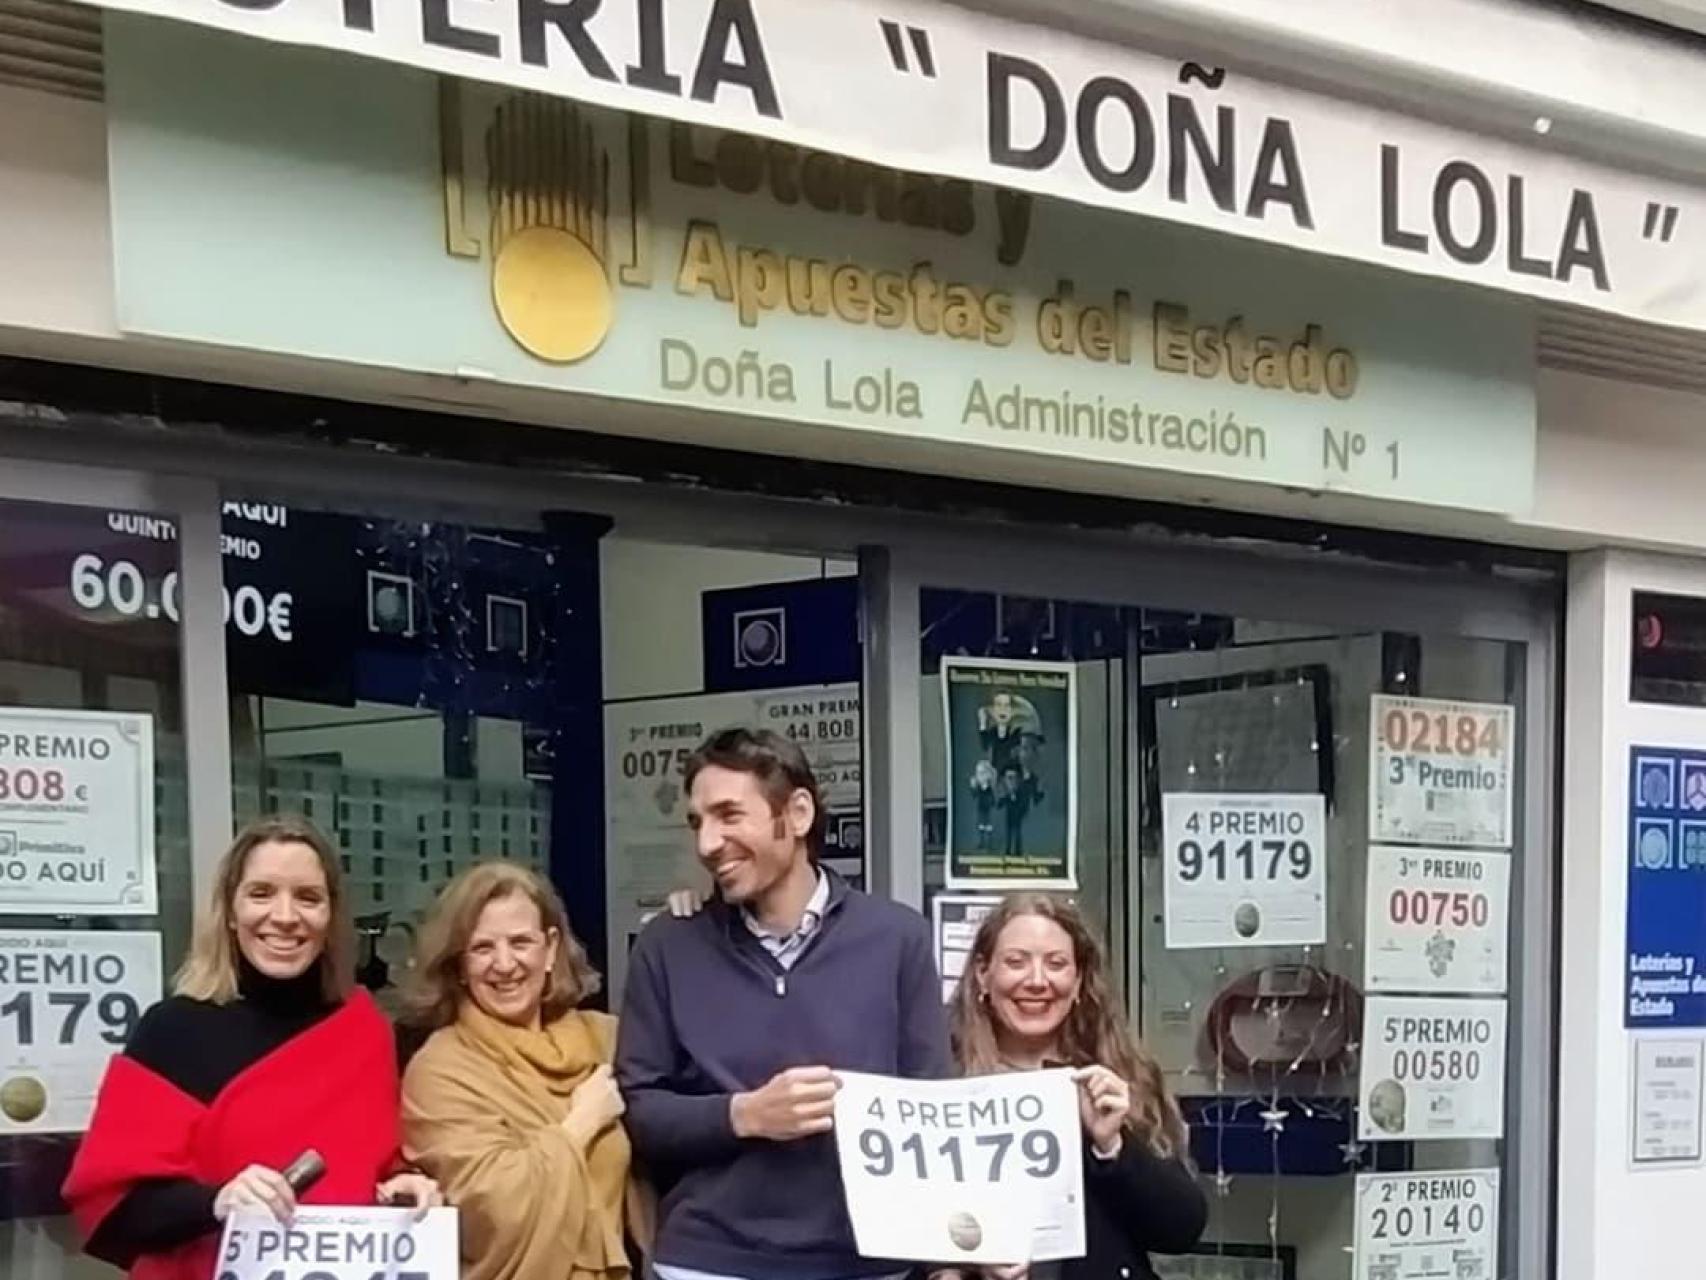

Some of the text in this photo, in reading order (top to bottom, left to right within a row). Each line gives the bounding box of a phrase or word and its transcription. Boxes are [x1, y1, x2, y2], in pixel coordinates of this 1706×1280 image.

[986, 52, 1314, 230] DOÑA
[1380, 143, 1612, 292] LOLA
[675, 218, 1360, 401] Apuestas del Estado
[659, 337, 796, 403] Doña
[824, 359, 923, 419] Lola
[961, 378, 1267, 460] Administración
[1385, 440, 1399, 480] 1
[769, 704, 813, 718] GRAN
[649, 721, 703, 740] PREMIO
[1385, 709, 1503, 758] 02184
[1419, 760, 1496, 791] Premio
[1209, 811, 1304, 835] PREMIO
[37, 857, 105, 884] AQUÍ
[1178, 839, 1312, 881] 91179
[1422, 858, 1483, 880] PREMIO
[1390, 889, 1489, 928] 00750
[1403, 1018, 1491, 1043] PREMIO
[1393, 1050, 1480, 1080] 00580
[867, 1094, 1044, 1129] 4 PREMIO
[859, 1128, 1061, 1183] 91179
[1407, 1178, 1477, 1202] PREMIO
[1371, 1203, 1485, 1239] 20140
[256, 1230, 416, 1264] PREMIO
